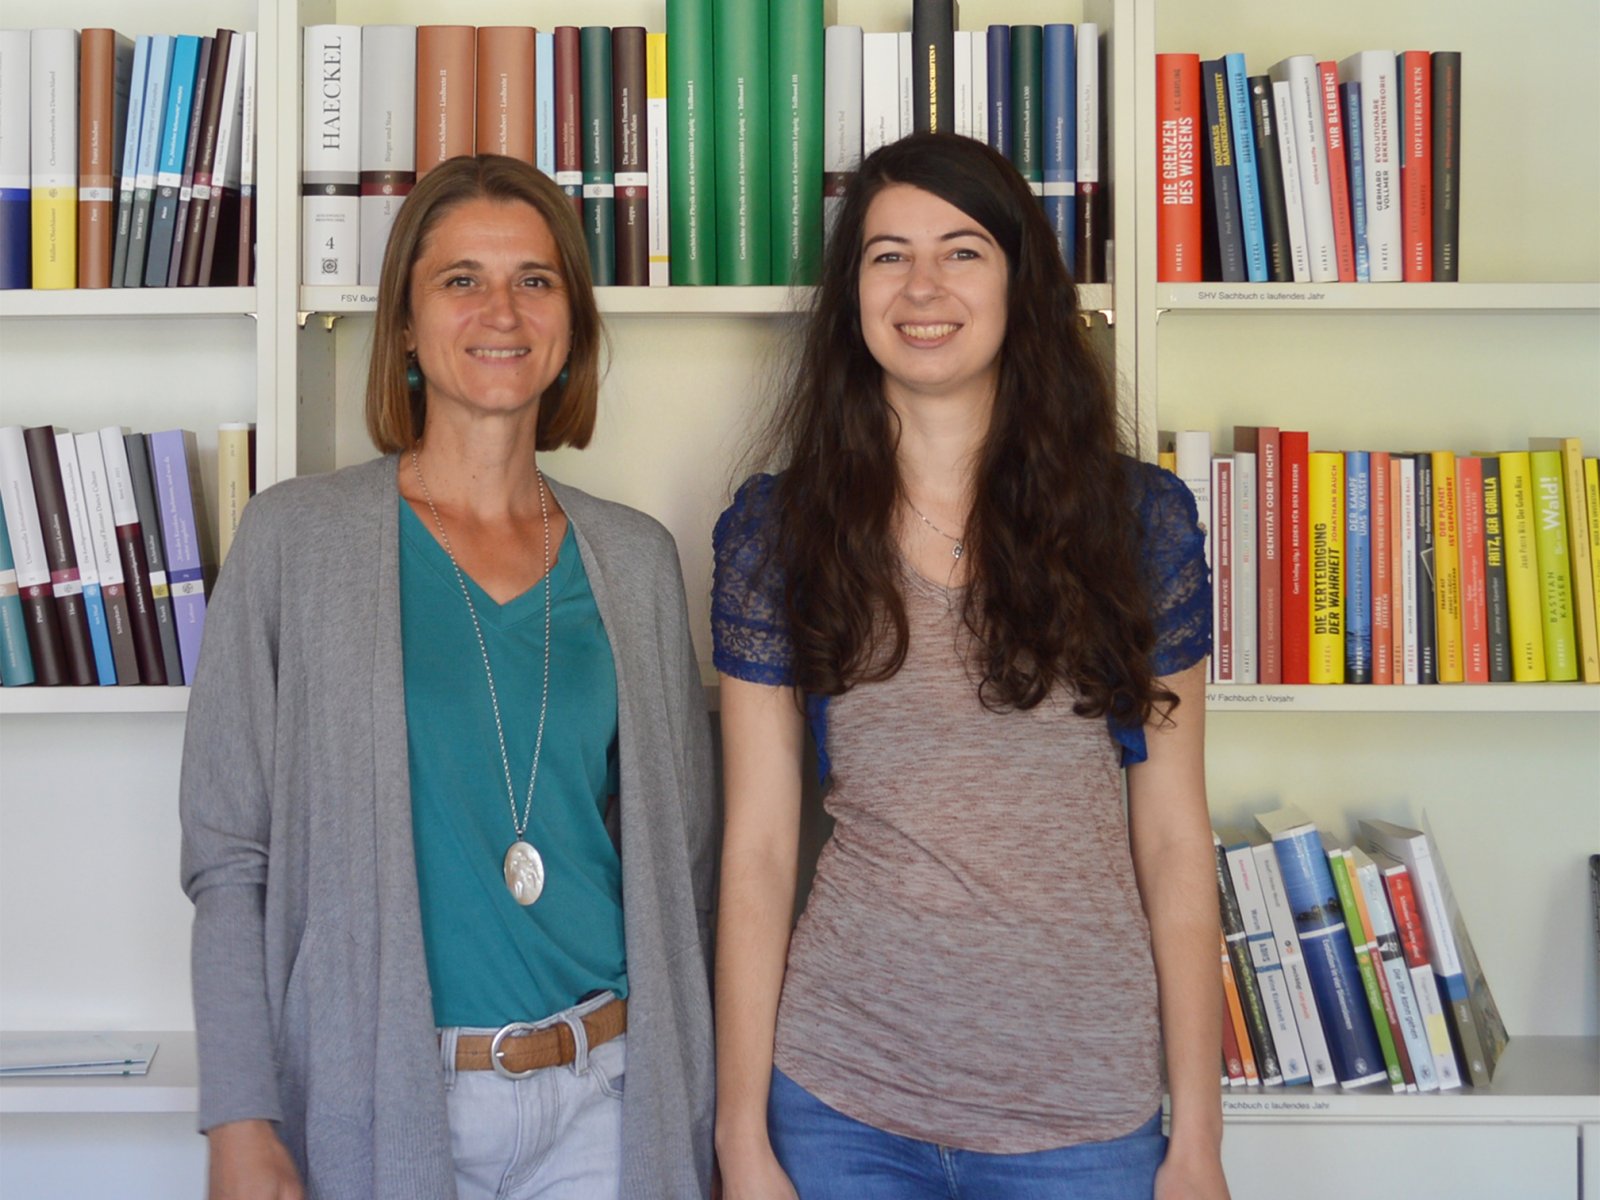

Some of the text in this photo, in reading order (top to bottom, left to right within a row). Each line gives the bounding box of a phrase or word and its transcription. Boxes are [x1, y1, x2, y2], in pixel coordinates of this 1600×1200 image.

[323, 36, 342, 150] HAECKEL
[1261, 99, 1269, 117] MAYER
[1214, 72, 1231, 166] MÄNNERGESUNDHEIT
[1324, 72, 1341, 149] WIR BLEIBEN!
[1380, 75, 1388, 163] ERKENNTNISTHEORIE
[1413, 66, 1423, 158] HOFLIEFERANTEN
[1213, 124, 1223, 166] KOMPASS
[1372, 99, 1381, 163] EVOLUTIONÄRE
[384, 142, 392, 162] Bürger
[688, 141, 696, 174] Universität
[738, 141, 746, 174] Universität
[1163, 120, 1177, 204] DIE GRENZEN
[1179, 116, 1193, 204] DES WISSENS
[1240, 132, 1252, 164] DIAGNOSE
[1248, 207, 1257, 231] PETER
[325, 236, 335, 250] 4
[1227, 243, 1236, 271] HIRZEL
[1252, 242, 1261, 270] HIRZEL
[1271, 241, 1281, 273] HIRZEL
[1320, 245, 1328, 272] HIRZEL
[341, 294, 358, 302] FSV
[1198, 292, 1215, 300] SHV
[1218, 291, 1258, 300] Sachbuch
[1267, 292, 1305, 300] laufendes
[1307, 292, 1326, 300] Jahr
[88, 470, 98, 492] Culture
[92, 493, 101, 511] Dance
[1349, 476, 1357, 531] DER KAMPF
[1359, 472, 1367, 536] UMS WASSER
[1445, 476, 1454, 532] GEPLÜNDERT
[1539, 475, 1561, 530] Wald!
[96, 512, 105, 533] Roman
[1265, 510, 1274, 560] IDENTITÄT
[1484, 477, 1502, 566] FRITZ, DER GORILLA
[56, 540, 66, 562] Eurasian
[100, 541, 111, 564] Aspects
[1314, 523, 1327, 634] DIE VERTEIDIGUNG
[1328, 547, 1340, 634] DER WAHRHEIT
[1547, 571, 1557, 623] BASTIAN
[1558, 574, 1567, 618] KAISER
[1494, 616, 1502, 634] Jenny
[1473, 642, 1481, 672] HIRZEL
[1525, 642, 1533, 670] HIRZEL
[1250, 909, 1287, 1032] Warum ADHS keine Krankheit ist
[1322, 938, 1337, 970] Evolution
[1393, 967, 1419, 1041] Die Uhr kann gehen
[1222, 1101, 1263, 1110] Fachbuch
[1271, 1101, 1311, 1110] laufendes
[1312, 1101, 1331, 1110] Jahr
